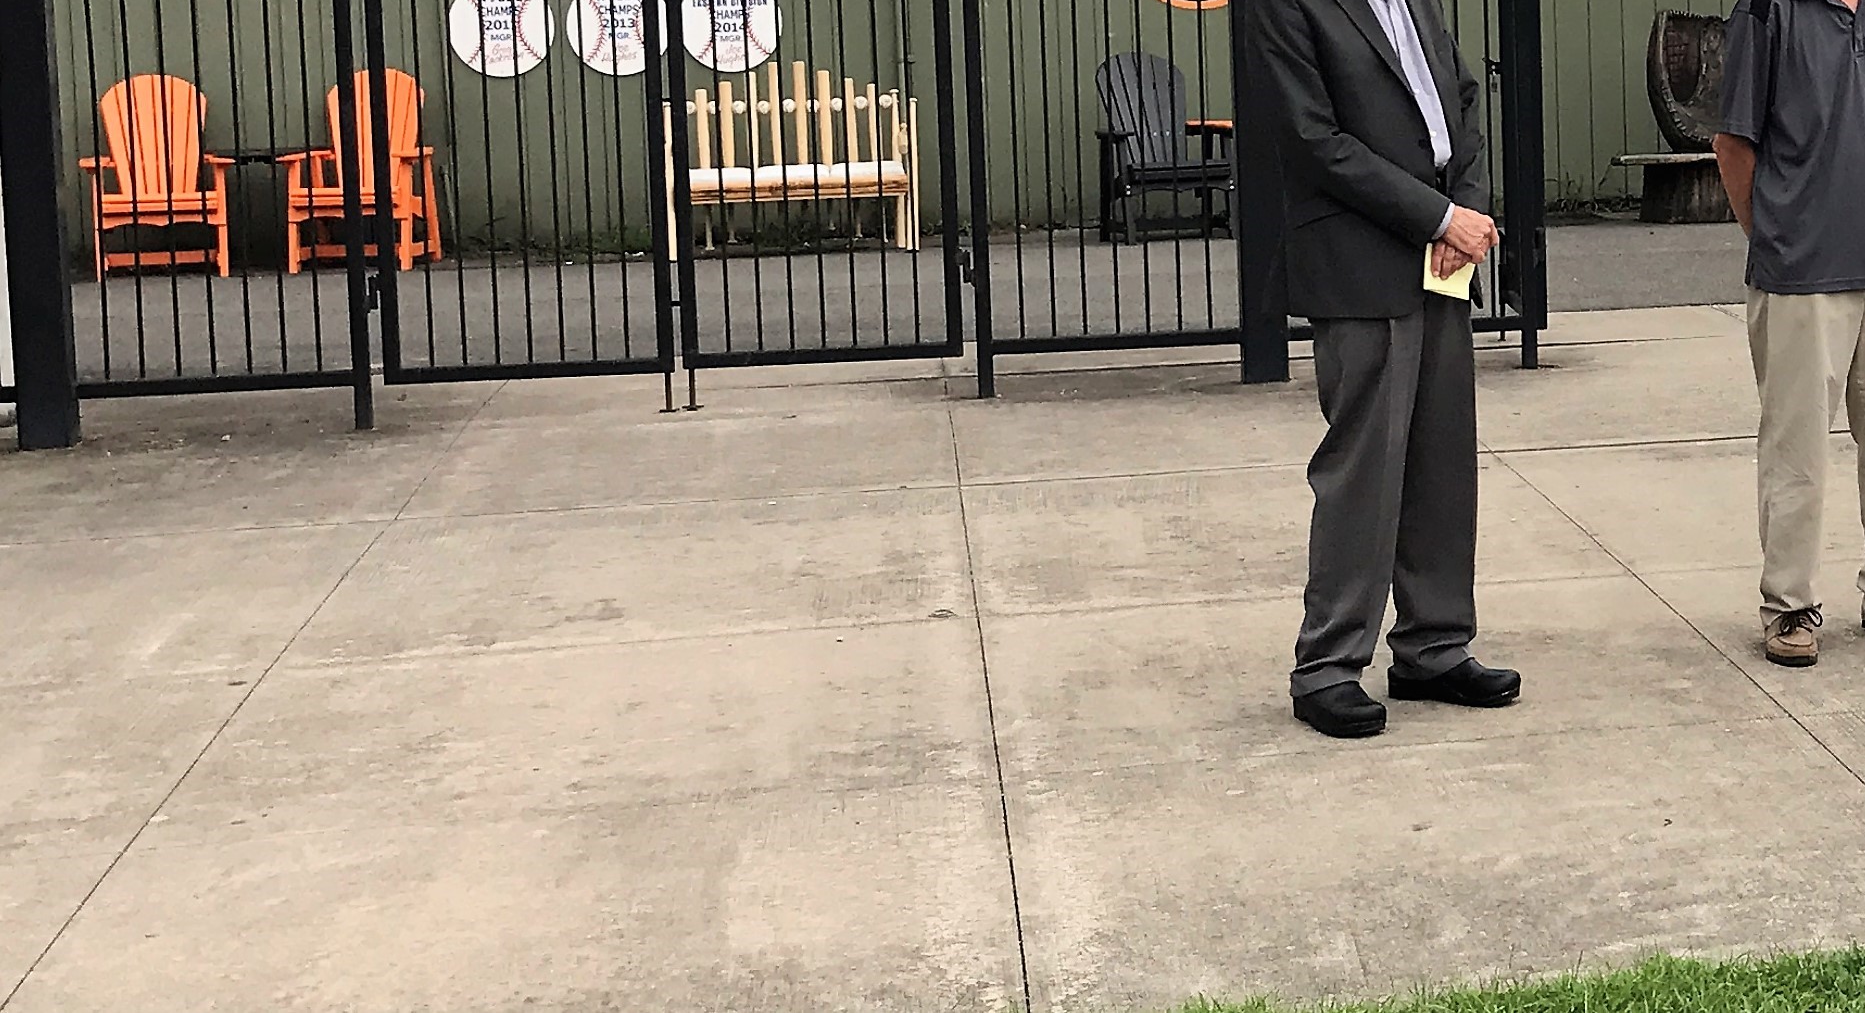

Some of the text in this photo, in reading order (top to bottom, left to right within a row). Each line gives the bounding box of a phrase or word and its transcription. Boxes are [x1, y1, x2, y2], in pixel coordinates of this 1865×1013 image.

[599, 5, 640, 15] CHAMPS
[713, 9, 750, 20] HAMP
[485, 20, 515, 30] 201
[602, 18, 636, 28] 2013
[715, 22, 746, 33] 2014
